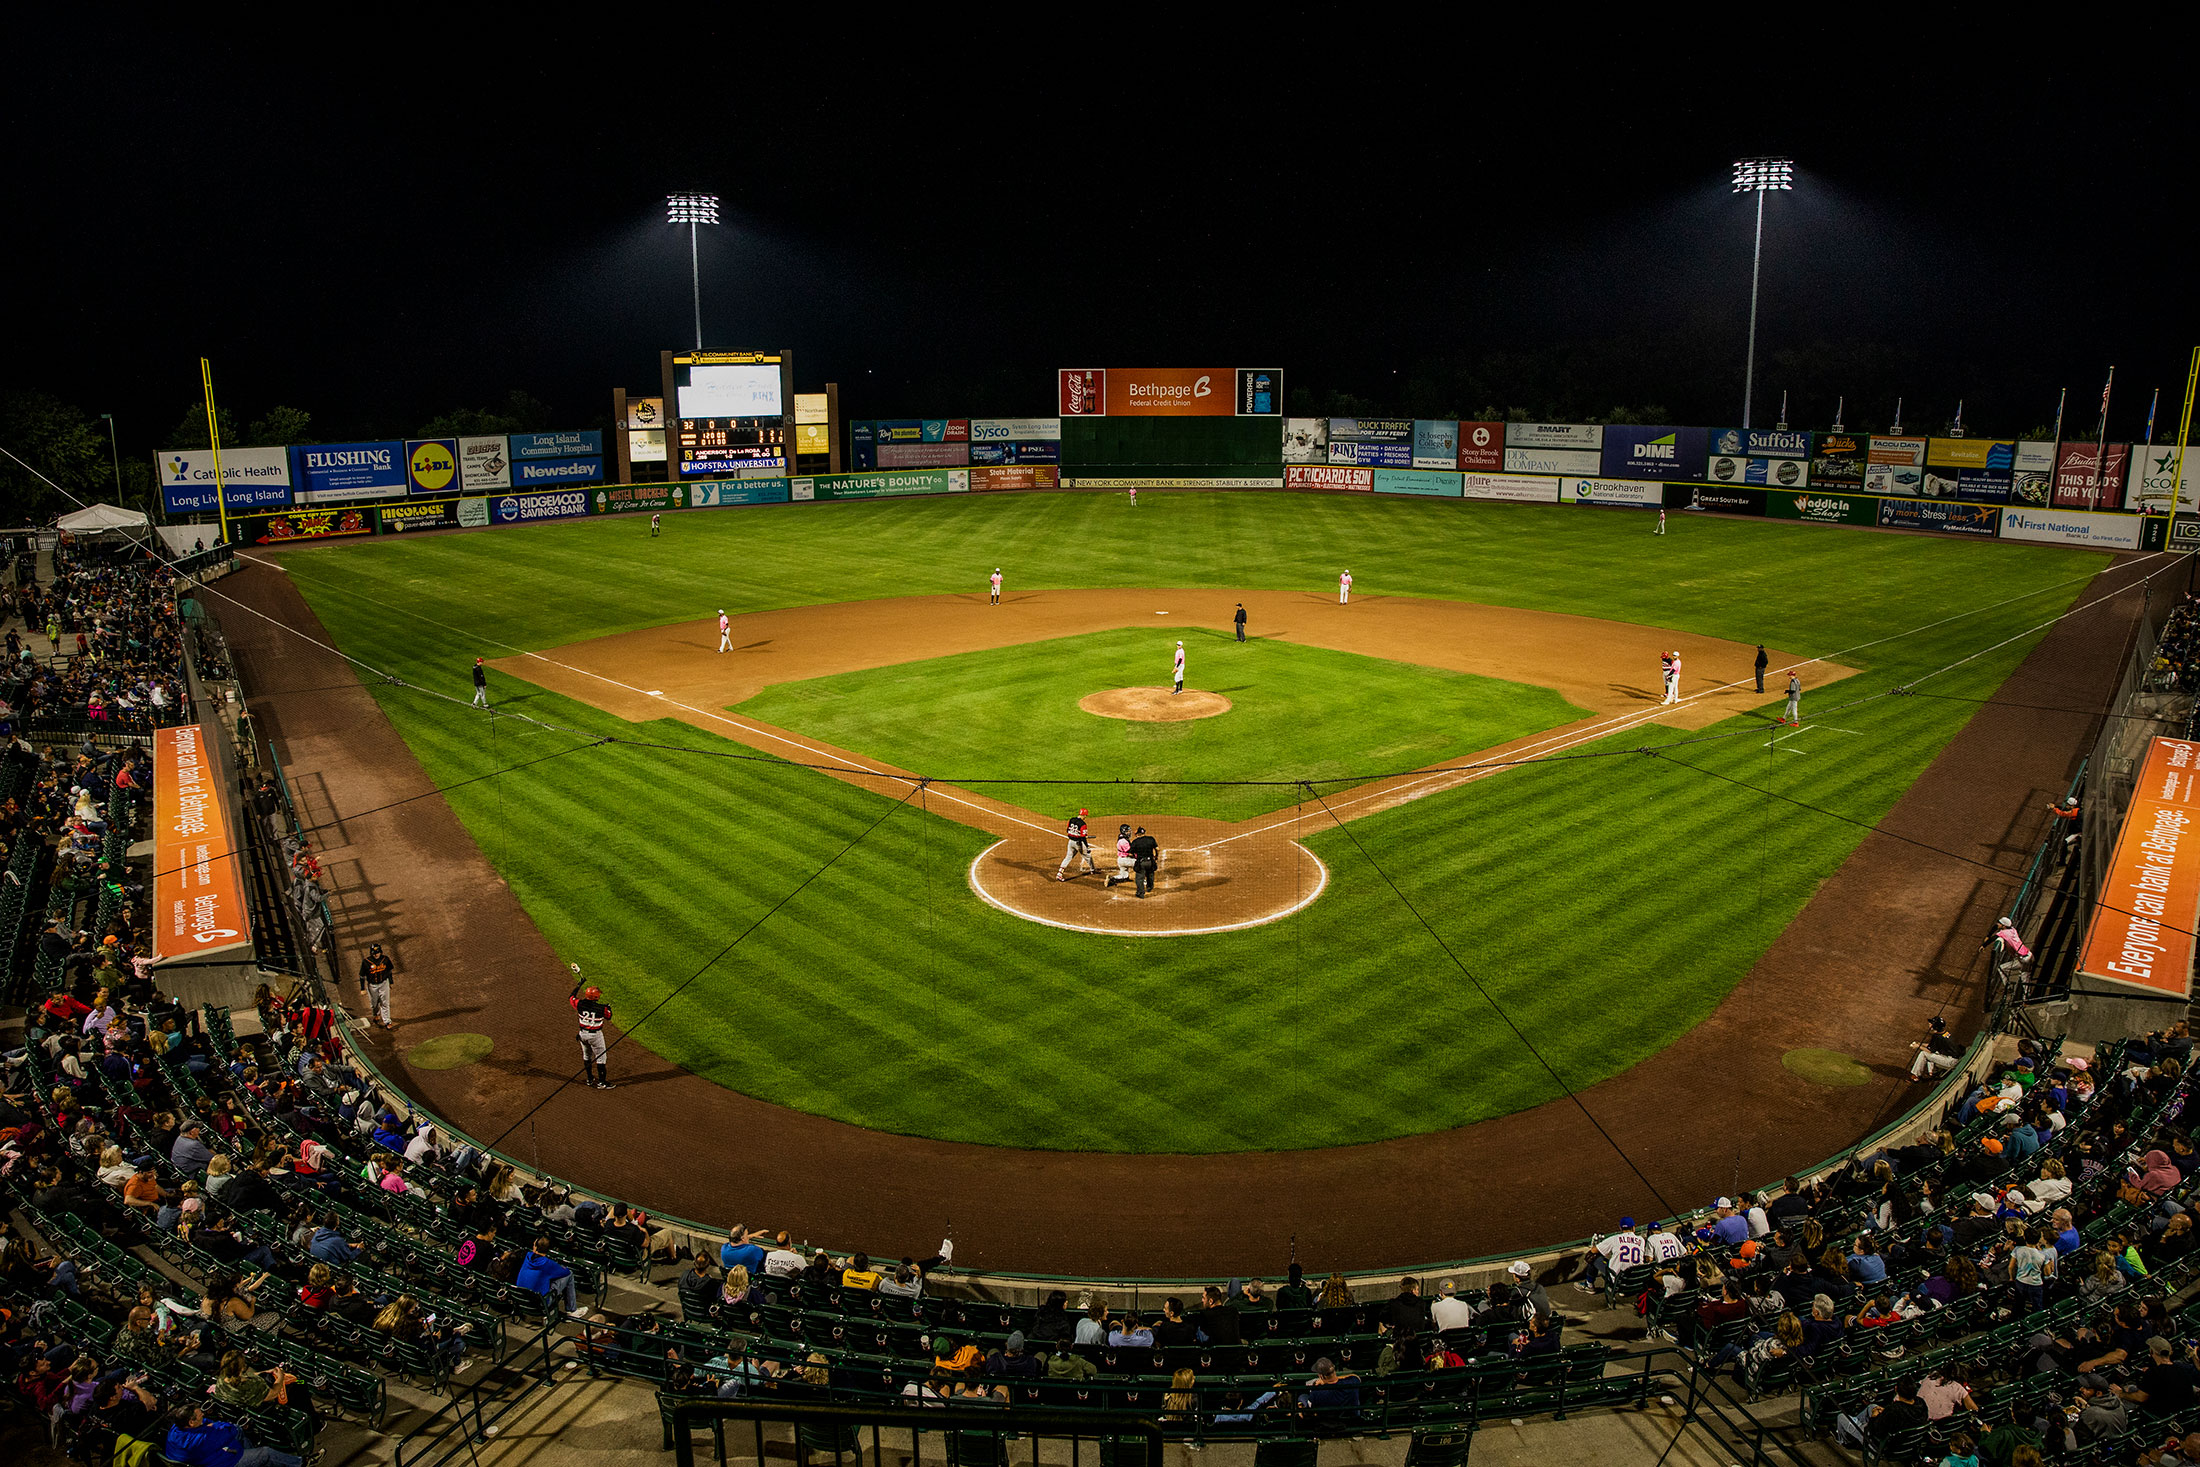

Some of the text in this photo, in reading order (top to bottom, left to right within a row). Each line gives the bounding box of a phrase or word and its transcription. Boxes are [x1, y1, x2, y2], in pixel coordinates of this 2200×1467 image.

[1068, 372, 1081, 413] Coca-Cola
[1130, 383, 1190, 398] Bethpage
[974, 425, 1009, 439] Sysco
[1358, 422, 1411, 430] DUCK TRAFFIC
[533, 433, 580, 446] Long Island
[1419, 440, 1445, 449] College
[522, 443, 592, 455] Community Hospital
[1333, 444, 1358, 458] RINX
[1462, 448, 1479, 456] Stony
[1507, 451, 1528, 460] DDK
[1634, 444, 1675, 458] DIME
[306, 449, 391, 467] FLUSHING
[244, 466, 281, 477] Health
[523, 462, 596, 478] Newsday
[692, 462, 728, 470] HOFSTRA
[1507, 460, 1558, 471] COMPANY
[833, 478, 885, 490] NATURE'S
[889, 476, 933, 486] BOUNTY
[1304, 468, 1372, 485] RICHARD & SON
[1466, 476, 1490, 489] Alure
[2060, 475, 2120, 487] THIS BD'S
[2143, 478, 2187, 489] SCOE
[1593, 482, 1644, 492] Brookhaven
[2058, 487, 2078, 497] FOR
[172, 489, 284, 507] Long Liv Long Island
[520, 493, 585, 509] RIDGEWOOD
[1793, 496, 1849, 511] Waddle In
[381, 504, 444, 519] NICOLOCK
[521, 503, 586, 518] SAVINGS BANK
[1811, 508, 1841, 518] Shop
[1883, 506, 1894, 517] Fly
[1922, 509, 1946, 520] Stress
[1949, 512, 1968, 522] less.
[1943, 524, 1992, 533] FlyMacArthur.com
[2024, 521, 2090, 534] First National
[170, 727, 199, 753] Everyone
[177, 754, 197, 766] can
[179, 766, 204, 785] bank
[180, 786, 202, 794] at
[2141, 849, 2175, 865] at
[2130, 864, 2172, 893] bank
[2133, 892, 2166, 915] can
[190, 894, 218, 931] Bethpage
[2107, 914, 2166, 978] Everyone
[582, 1011, 596, 1023] 21
[1619, 1236, 1641, 1246] ALONSO
[1620, 1245, 1640, 1264] 20
[1662, 1245, 1676, 1258] 20
